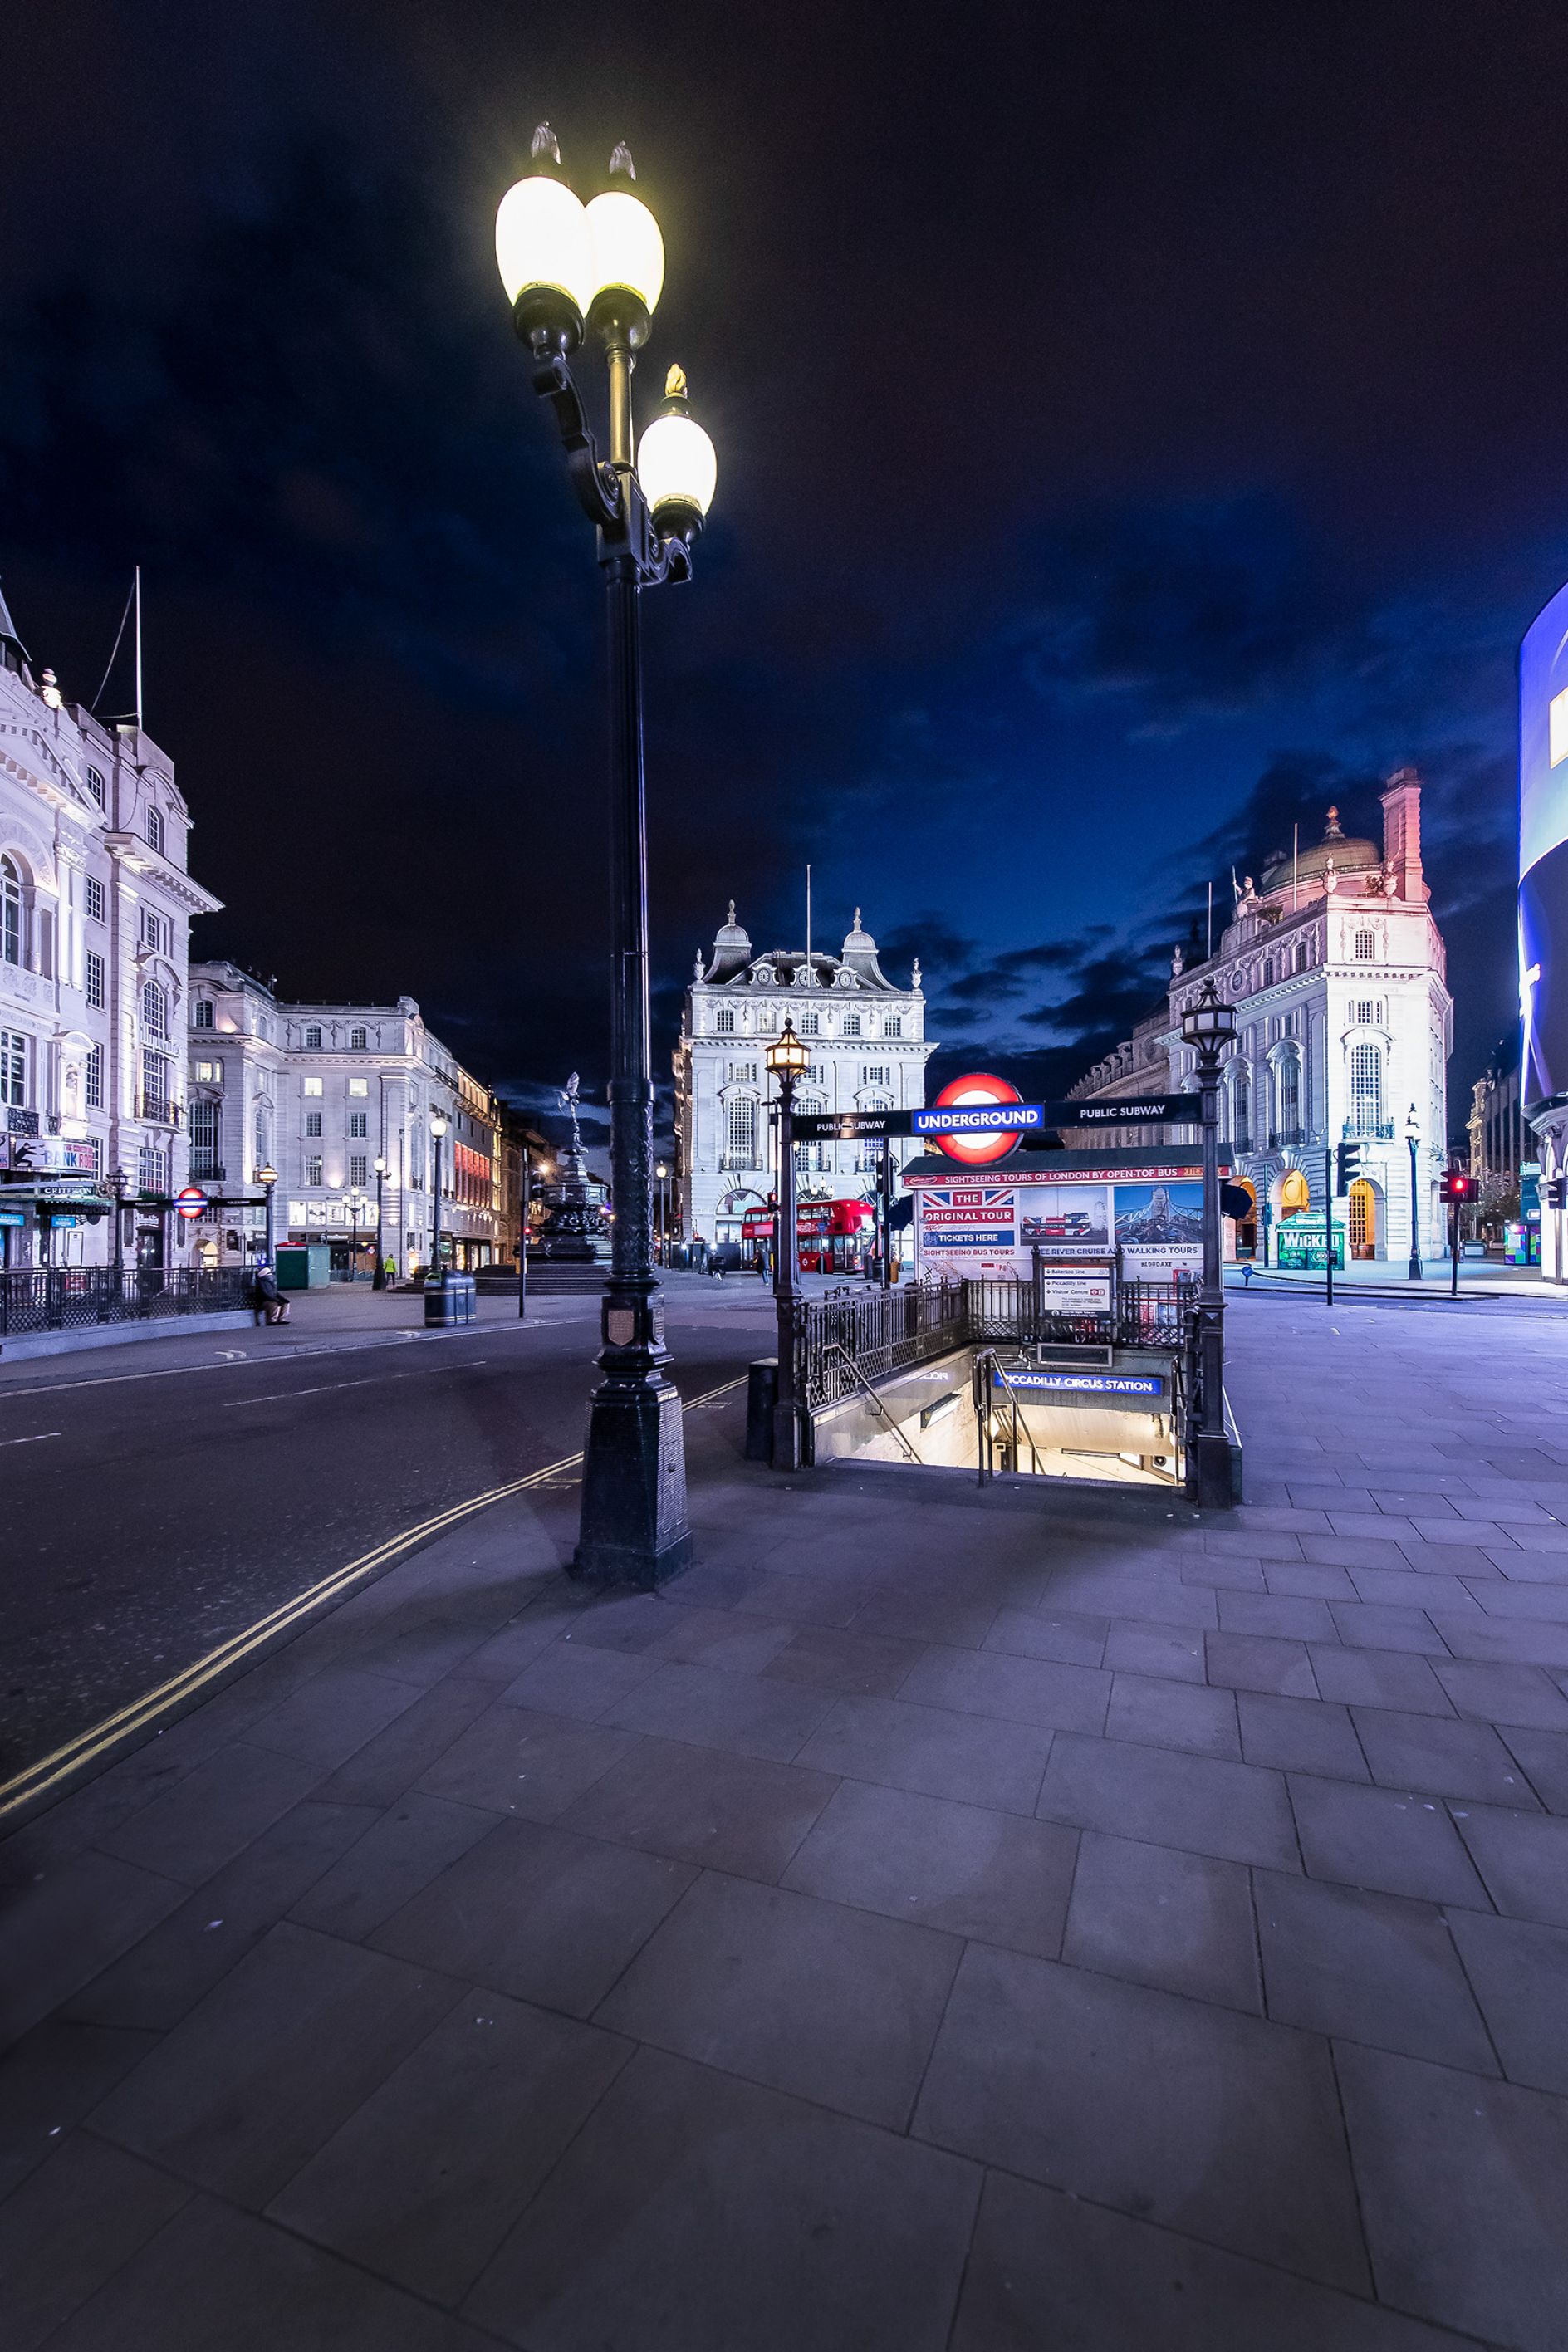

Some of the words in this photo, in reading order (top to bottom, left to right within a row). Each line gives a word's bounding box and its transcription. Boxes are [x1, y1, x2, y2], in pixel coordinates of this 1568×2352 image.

[1080, 1108, 1118, 1119] PUBLIC
[1120, 1105, 1165, 1116] SUBWAY
[816, 1123, 845, 1132] PUBLIC
[849, 1120, 886, 1130] SUBWAY
[918, 1110, 1038, 1129] UNDERGROUND
[44, 1149, 77, 1168] BANK
[945, 1174, 1001, 1183] SIGHTSEEING
[1002, 1174, 1033, 1182] TOURS
[1035, 1173, 1047, 1181] OF
[1049, 1171, 1090, 1180] LONDON
[1092, 1170, 1105, 1179] BY
[1106, 1169, 1155, 1178] OPEN-TOP
[1158, 1168, 1178, 1177] BUS
[956, 1194, 978, 1203] THE
[925, 1212, 978, 1221] ORIGINAL
[980, 1211, 1012, 1220] TOUR
[938, 1234, 974, 1242] TICKETS
[975, 1233, 998, 1242] HERE
[1006, 1374, 1061, 1387] PICCADILLY
[1063, 1377, 1104, 1389] CIRCUS
[1105, 1380, 1153, 1393] STATION
